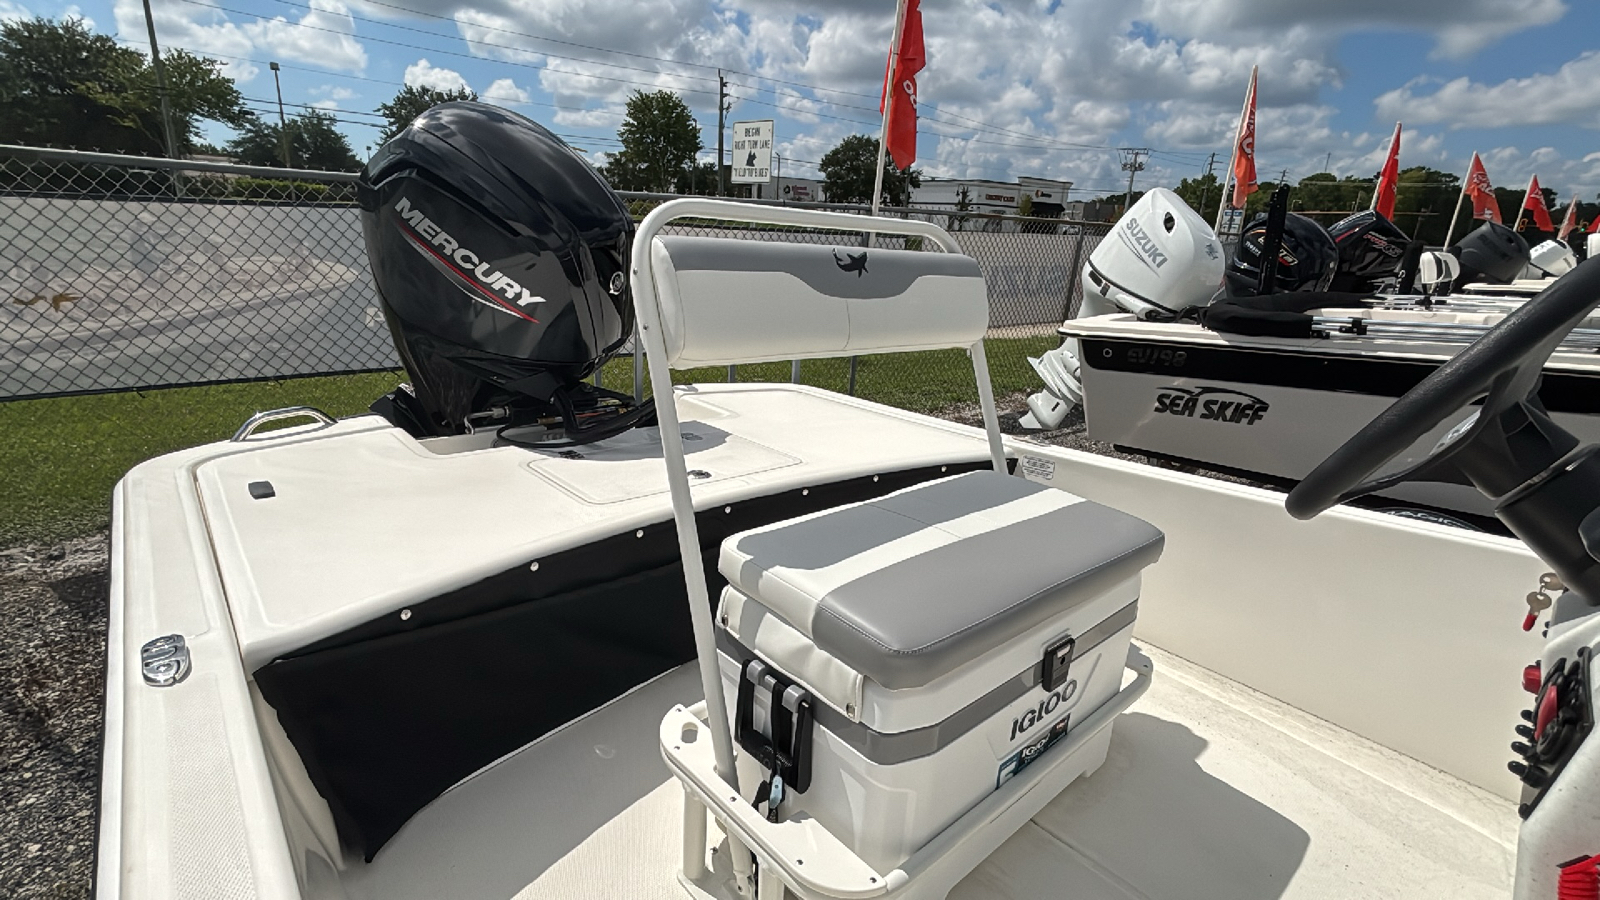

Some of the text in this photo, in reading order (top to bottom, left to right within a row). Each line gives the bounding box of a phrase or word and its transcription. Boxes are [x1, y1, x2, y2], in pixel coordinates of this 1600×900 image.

[744, 127, 761, 138] BEGIN
[394, 196, 547, 307] MERCURY
[1126, 217, 1169, 269] SUZUKI
[1154, 393, 1269, 426] SEA SKIFF
[1009, 678, 1078, 742] IGLOO
